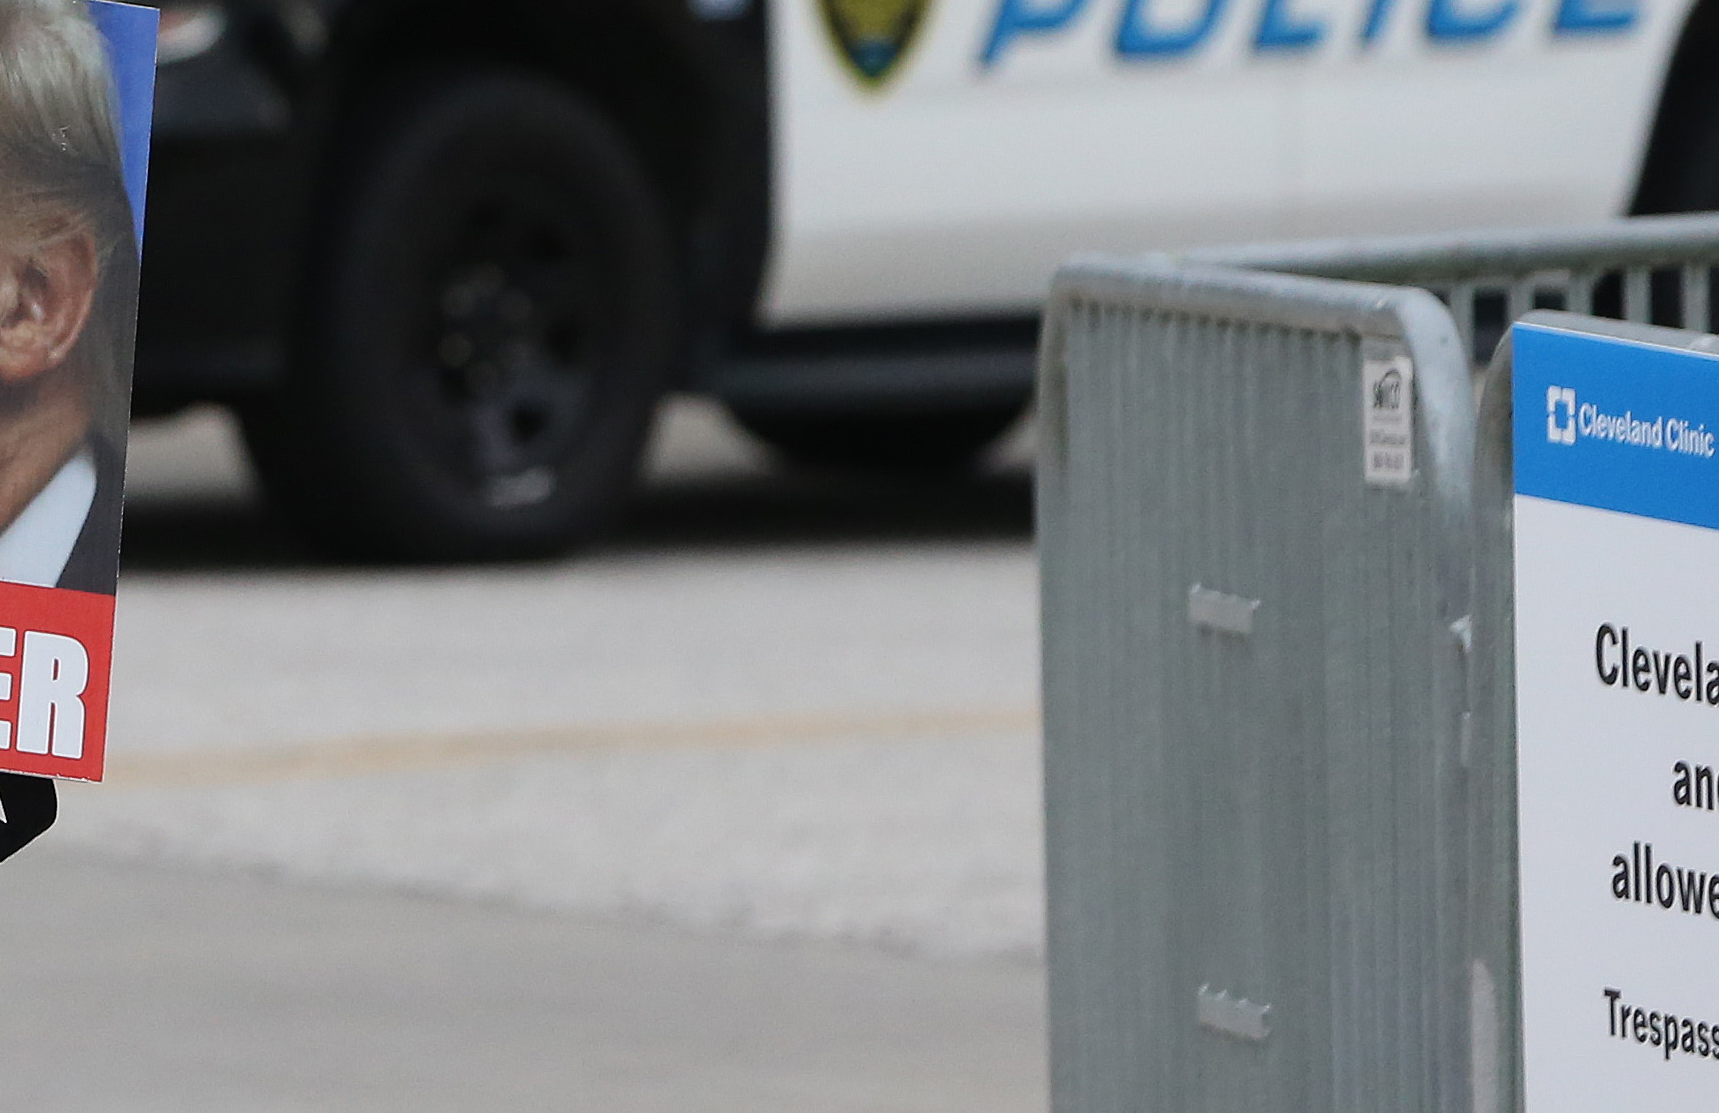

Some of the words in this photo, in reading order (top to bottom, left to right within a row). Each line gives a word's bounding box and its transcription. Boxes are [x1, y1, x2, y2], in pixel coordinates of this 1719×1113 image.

[1579, 402, 1663, 449] Cleveland
[1667, 417, 1716, 458] Clinic
[1673, 760, 1719, 810] an
